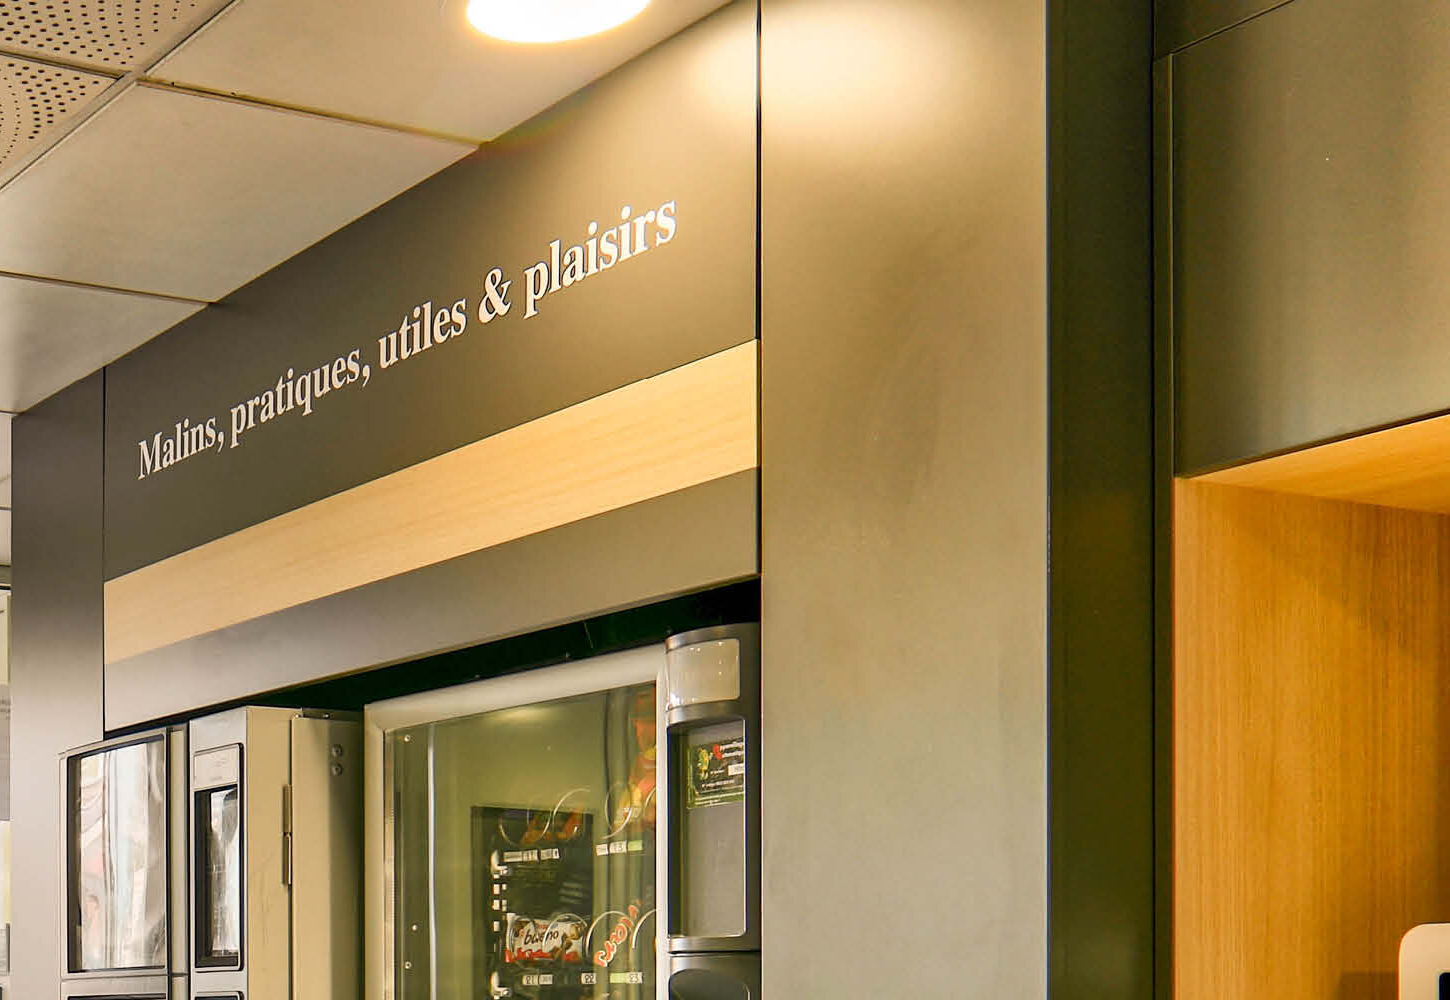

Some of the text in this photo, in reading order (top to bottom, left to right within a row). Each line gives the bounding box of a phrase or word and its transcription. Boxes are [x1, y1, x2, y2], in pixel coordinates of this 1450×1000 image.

[138, 200, 678, 480] Malins, pratiques, utiles & plaisirs
